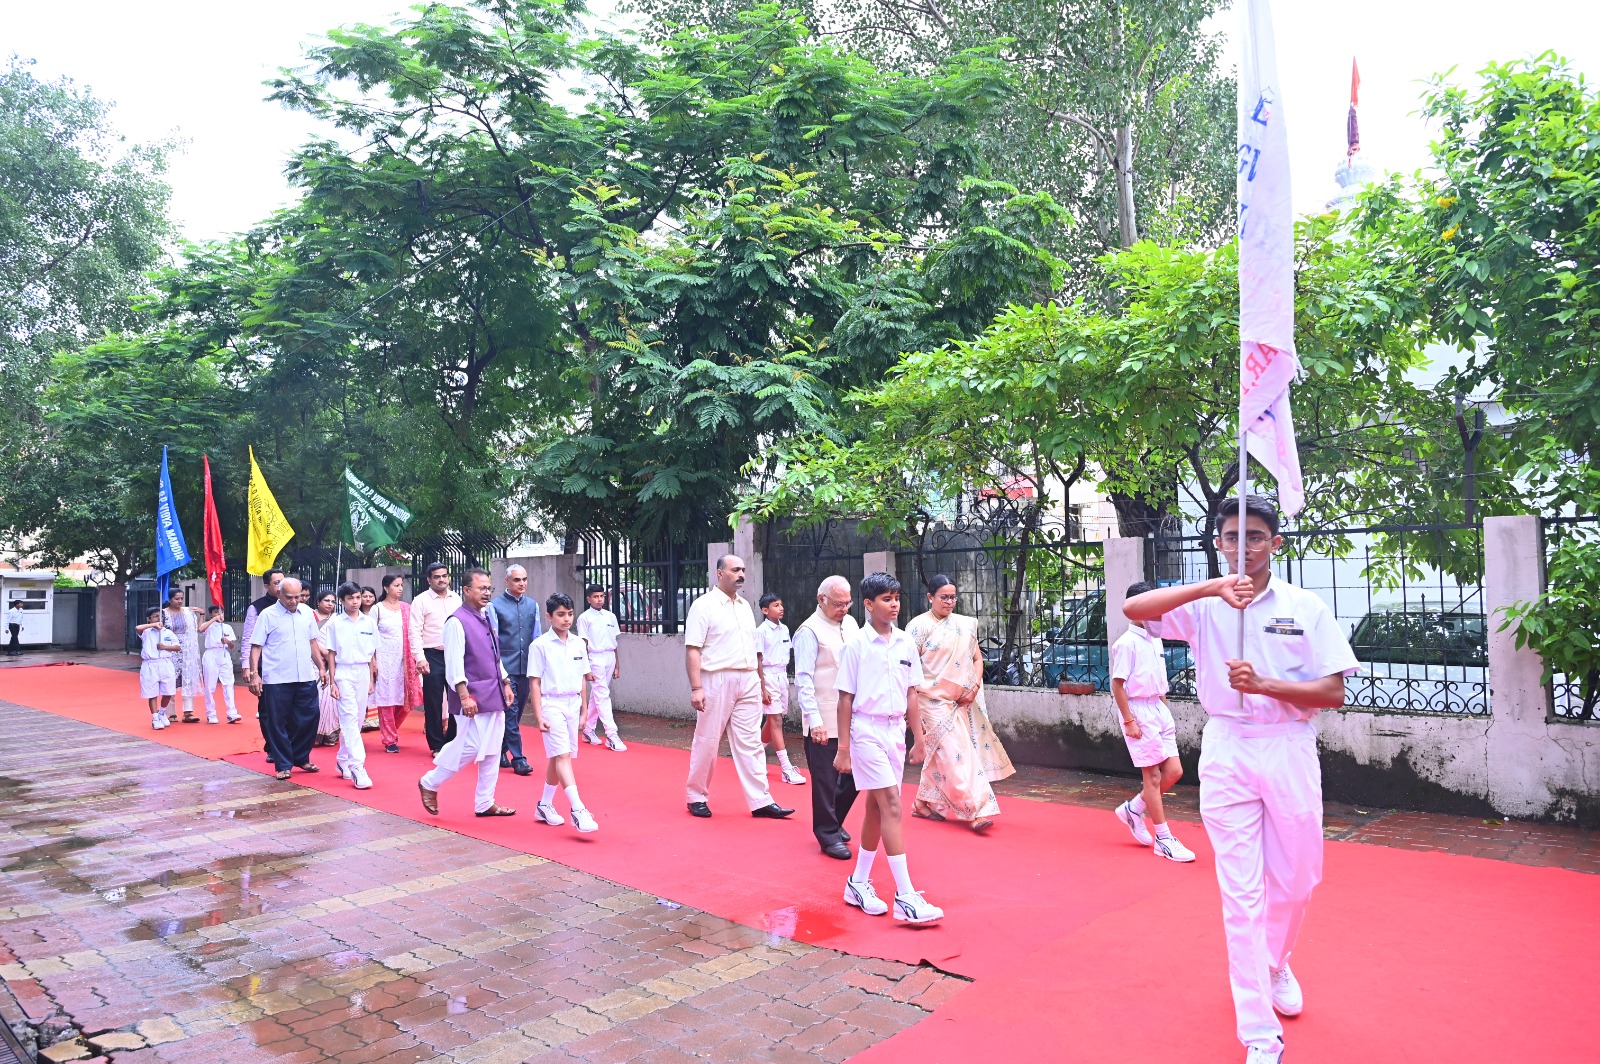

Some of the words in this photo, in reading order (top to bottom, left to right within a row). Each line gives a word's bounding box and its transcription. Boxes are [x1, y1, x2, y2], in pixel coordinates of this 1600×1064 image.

[159, 502, 173, 528] VIDYA
[367, 506, 388, 523] NAGAR
[386, 503, 411, 523] MANDIR
[165, 528, 185, 561] MANDIR
